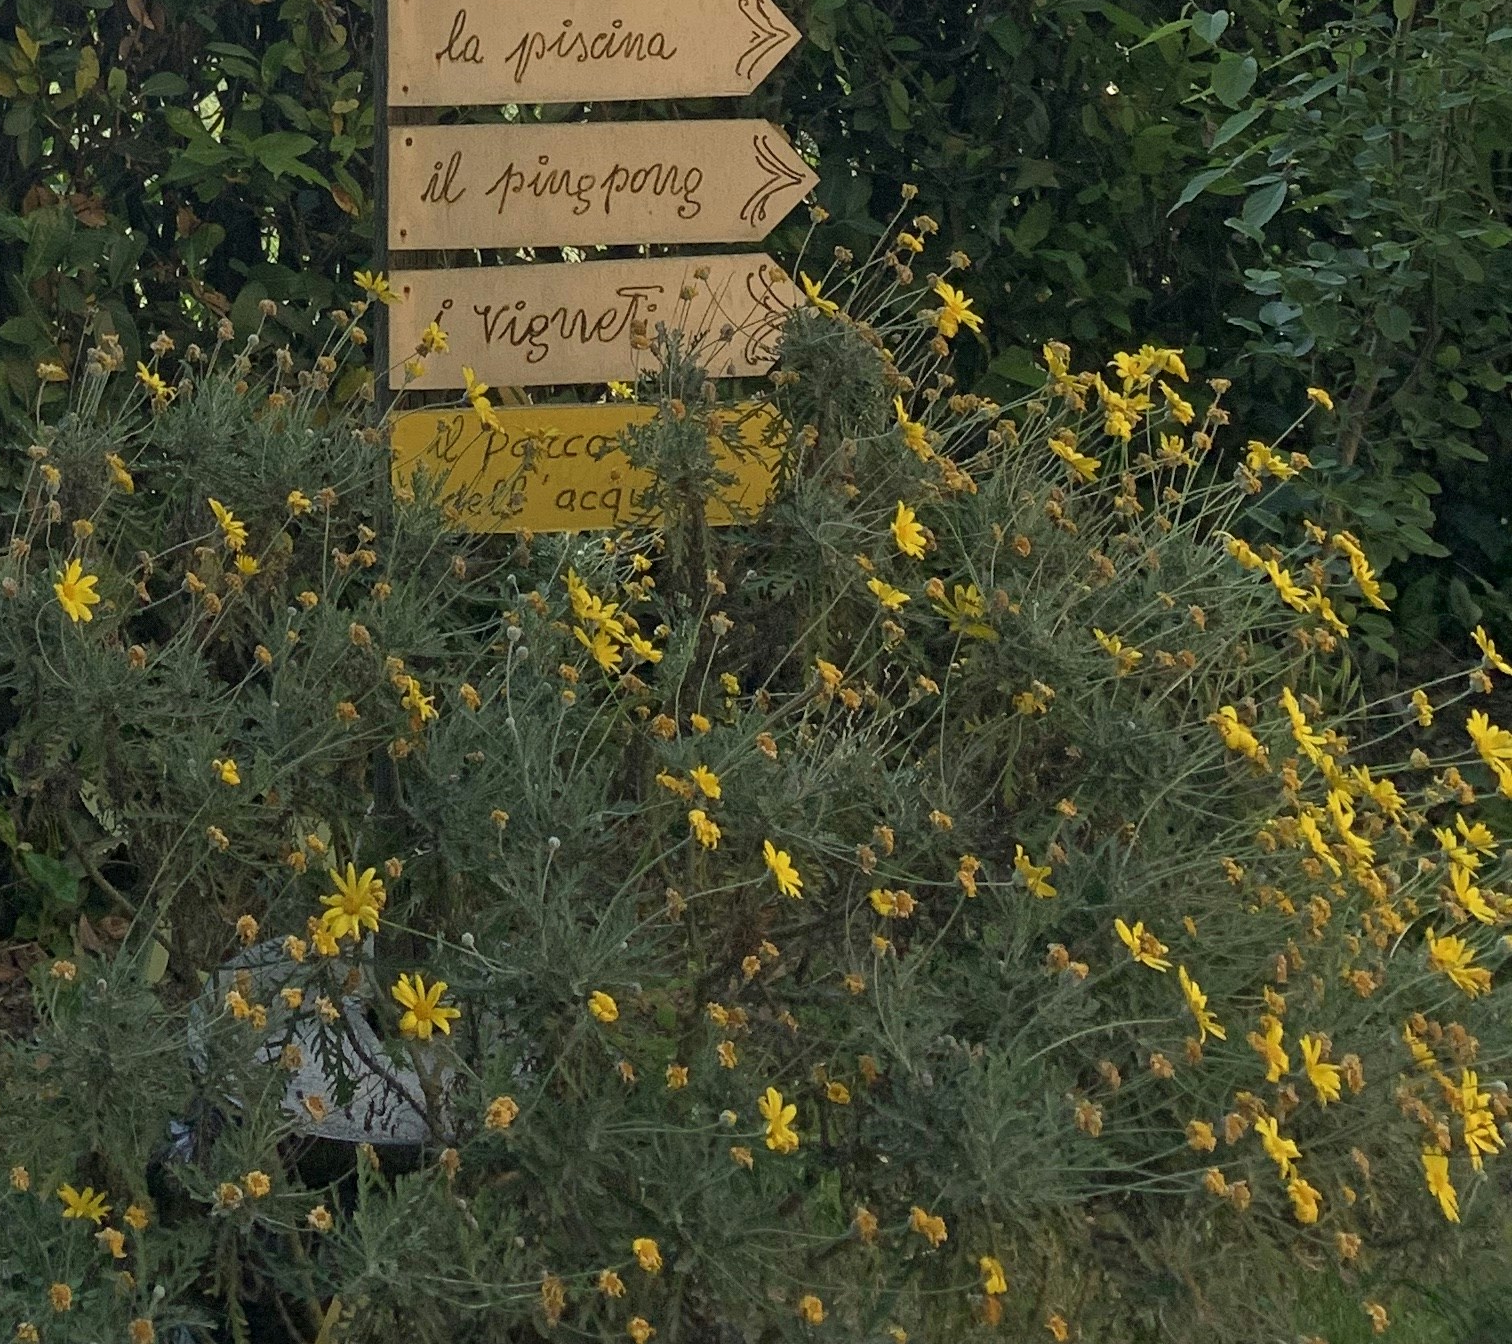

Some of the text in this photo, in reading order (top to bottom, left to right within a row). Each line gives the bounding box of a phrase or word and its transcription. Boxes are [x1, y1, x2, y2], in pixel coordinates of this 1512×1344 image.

[435, 9, 677, 83] la piscina
[420, 150, 466, 204] il
[427, 415, 464, 462] il
